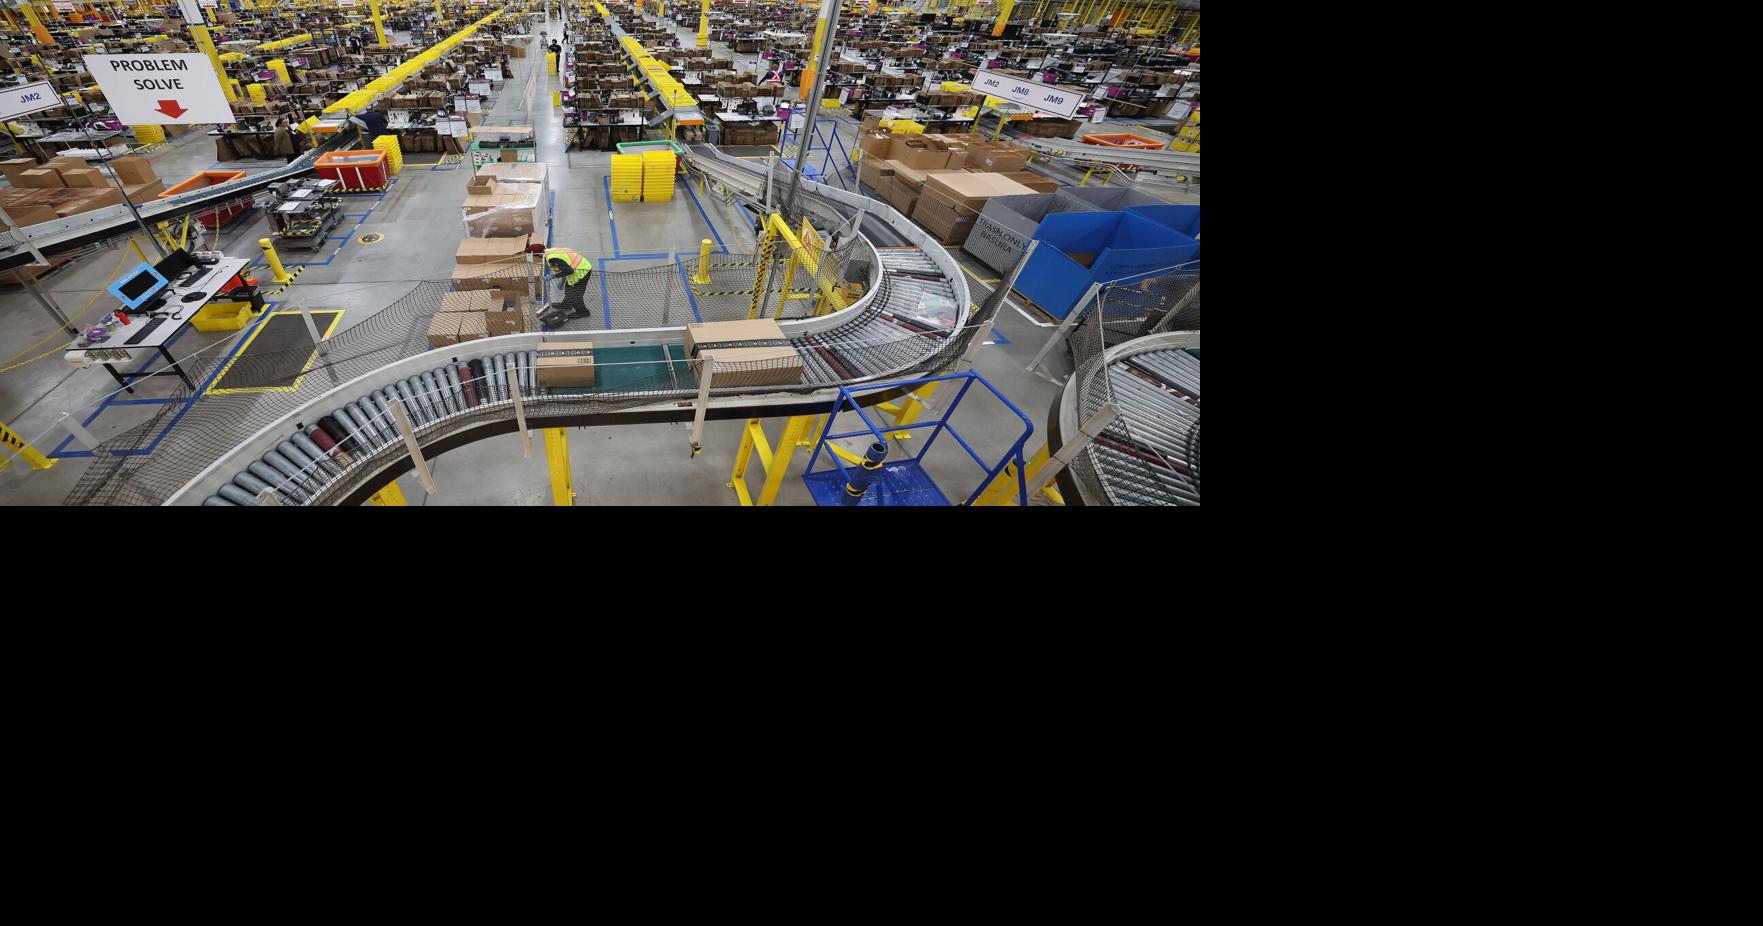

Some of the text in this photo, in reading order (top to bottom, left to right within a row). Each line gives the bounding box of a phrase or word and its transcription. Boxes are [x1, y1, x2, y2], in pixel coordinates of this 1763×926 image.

[110, 59, 188, 72] PROBLEM
[134, 78, 184, 90] SOLVE
[984, 79, 1064, 105] JM2 JM8 JM9
[20, 92, 41, 104] JM2
[980, 218, 1028, 250] TRASH ONLY
[980, 230, 1012, 253] BASURA
